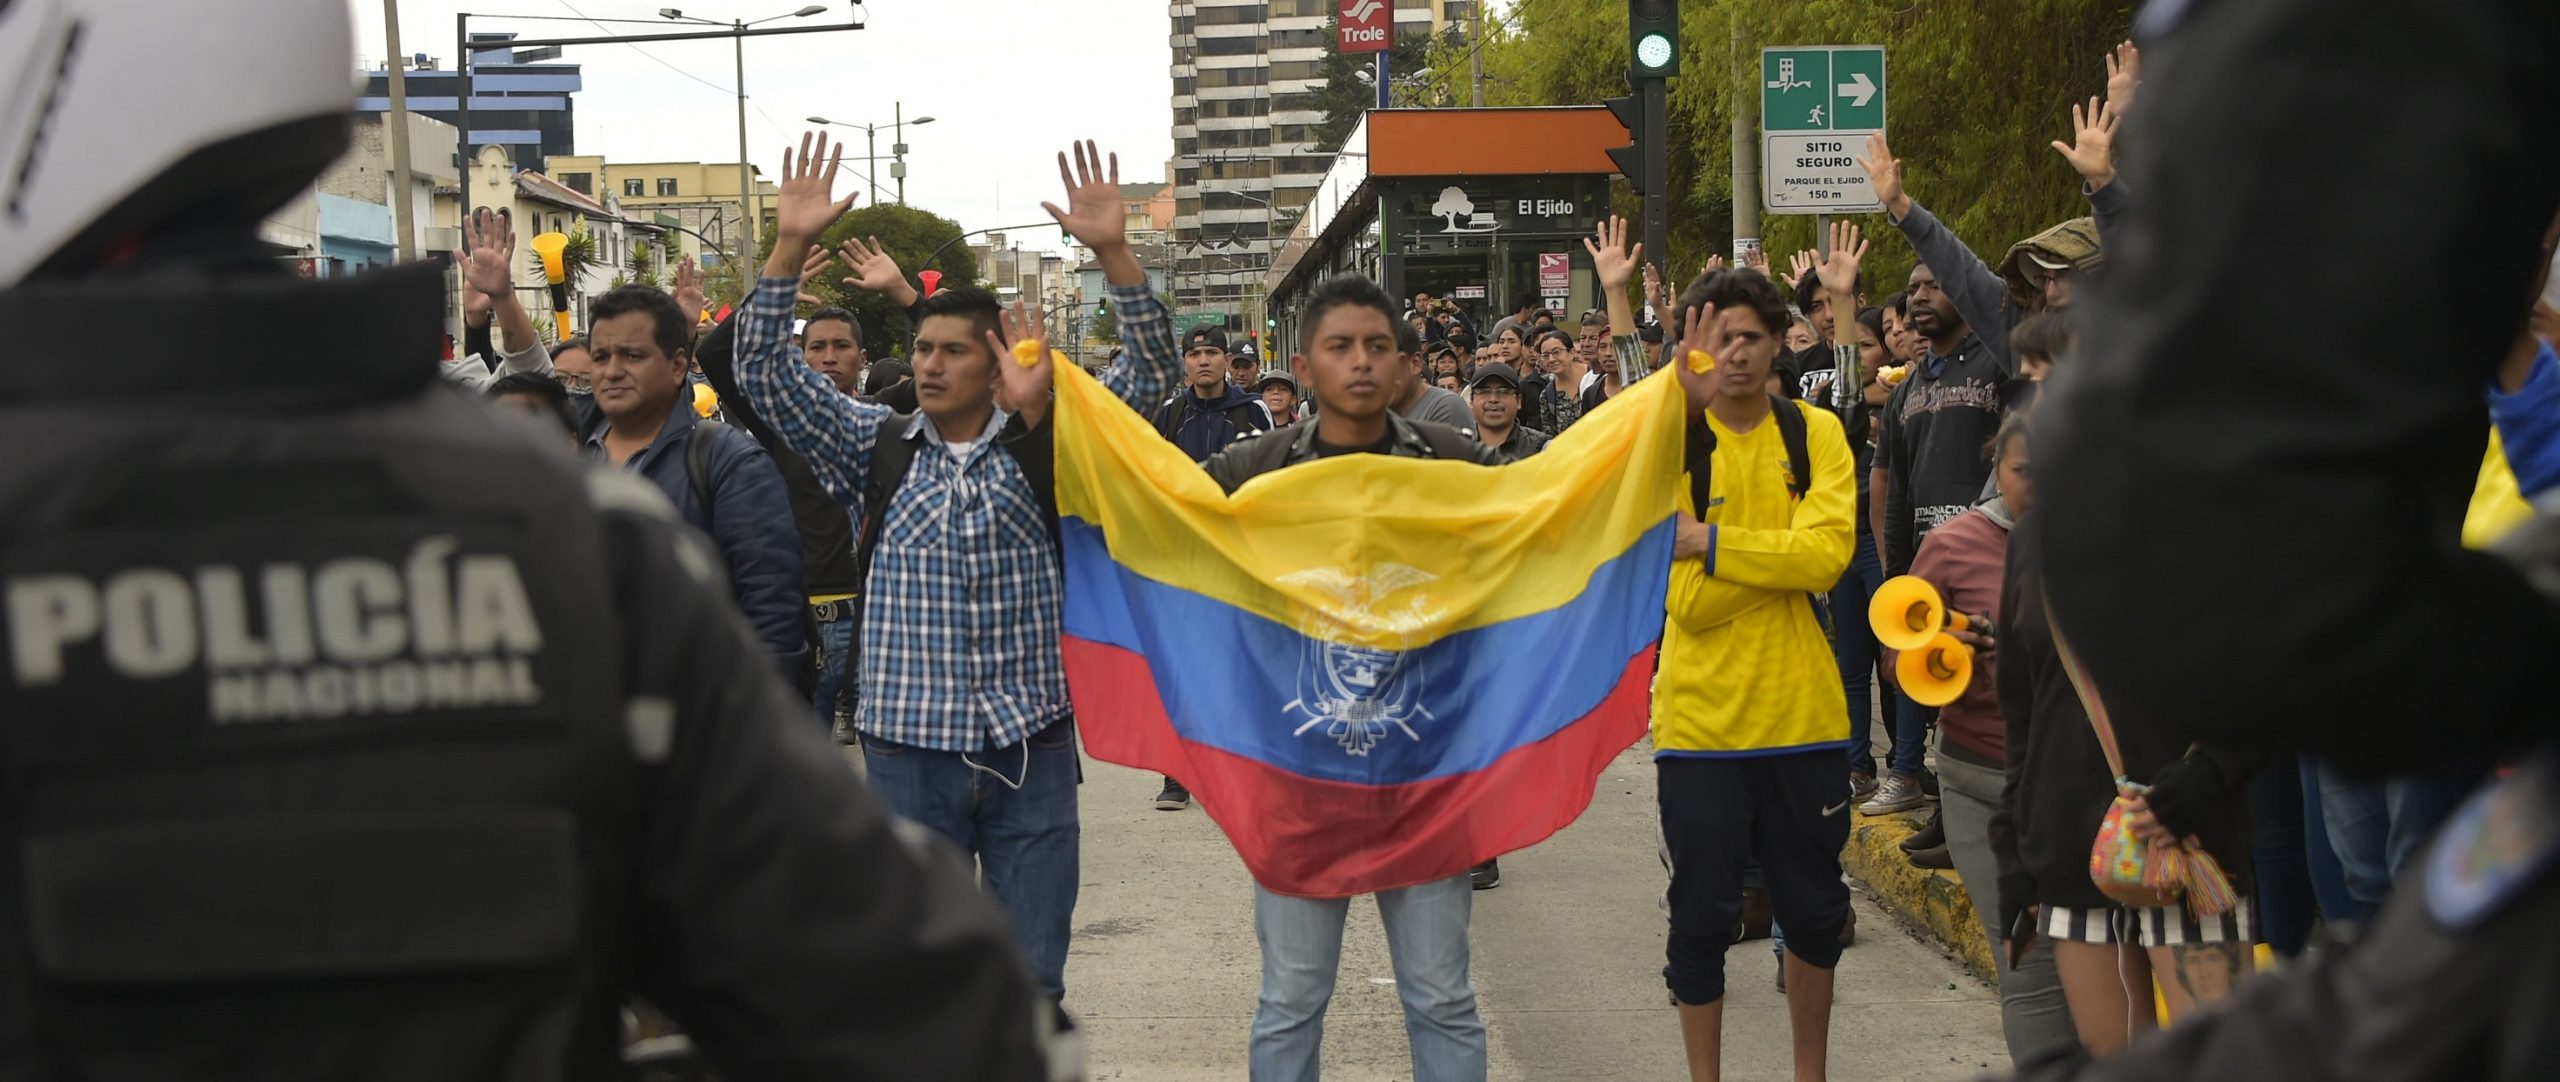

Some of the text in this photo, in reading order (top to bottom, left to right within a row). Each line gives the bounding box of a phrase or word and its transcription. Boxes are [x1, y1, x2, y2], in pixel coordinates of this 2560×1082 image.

[1342, 26, 1384, 42] Trole
[1806, 142, 1842, 152] SITIO
[1796, 157, 1852, 167] SEGURO
[1784, 177, 1821, 185] PARQUE
[1809, 190, 1828, 199] 150
[1519, 199, 1573, 217] El Ejido
[6, 536, 542, 686] POLICÍA
[211, 659, 540, 722] NACIONAL
